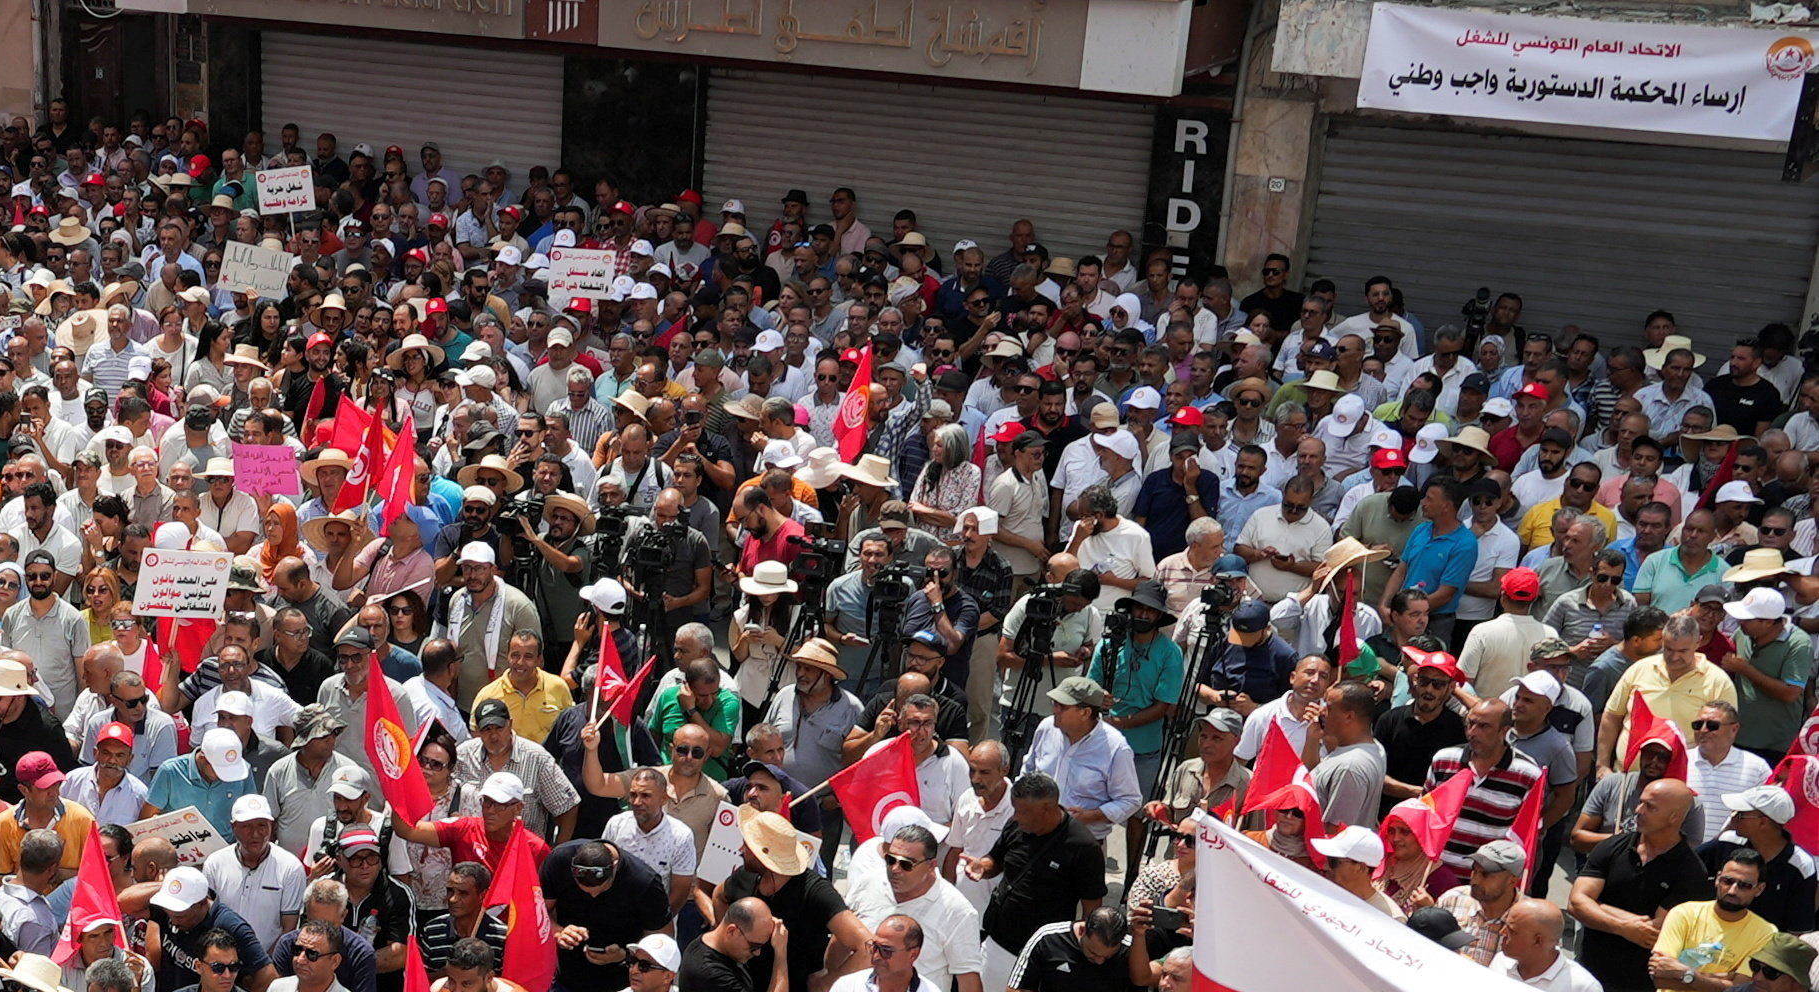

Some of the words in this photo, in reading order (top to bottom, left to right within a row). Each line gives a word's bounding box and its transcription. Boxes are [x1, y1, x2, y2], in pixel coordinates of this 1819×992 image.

[1456, 29, 1510, 48] للشغل
[1513, 37, 1578, 58] التونسي
[1582, 40, 1623, 59] العام
[1628, 43, 1681, 58] الاتحاد
[1388, 62, 1443, 97] وطني
[1449, 67, 1499, 95] واجب
[1505, 67, 1603, 103] الدستورية
[1609, 74, 1686, 107] المحكمة
